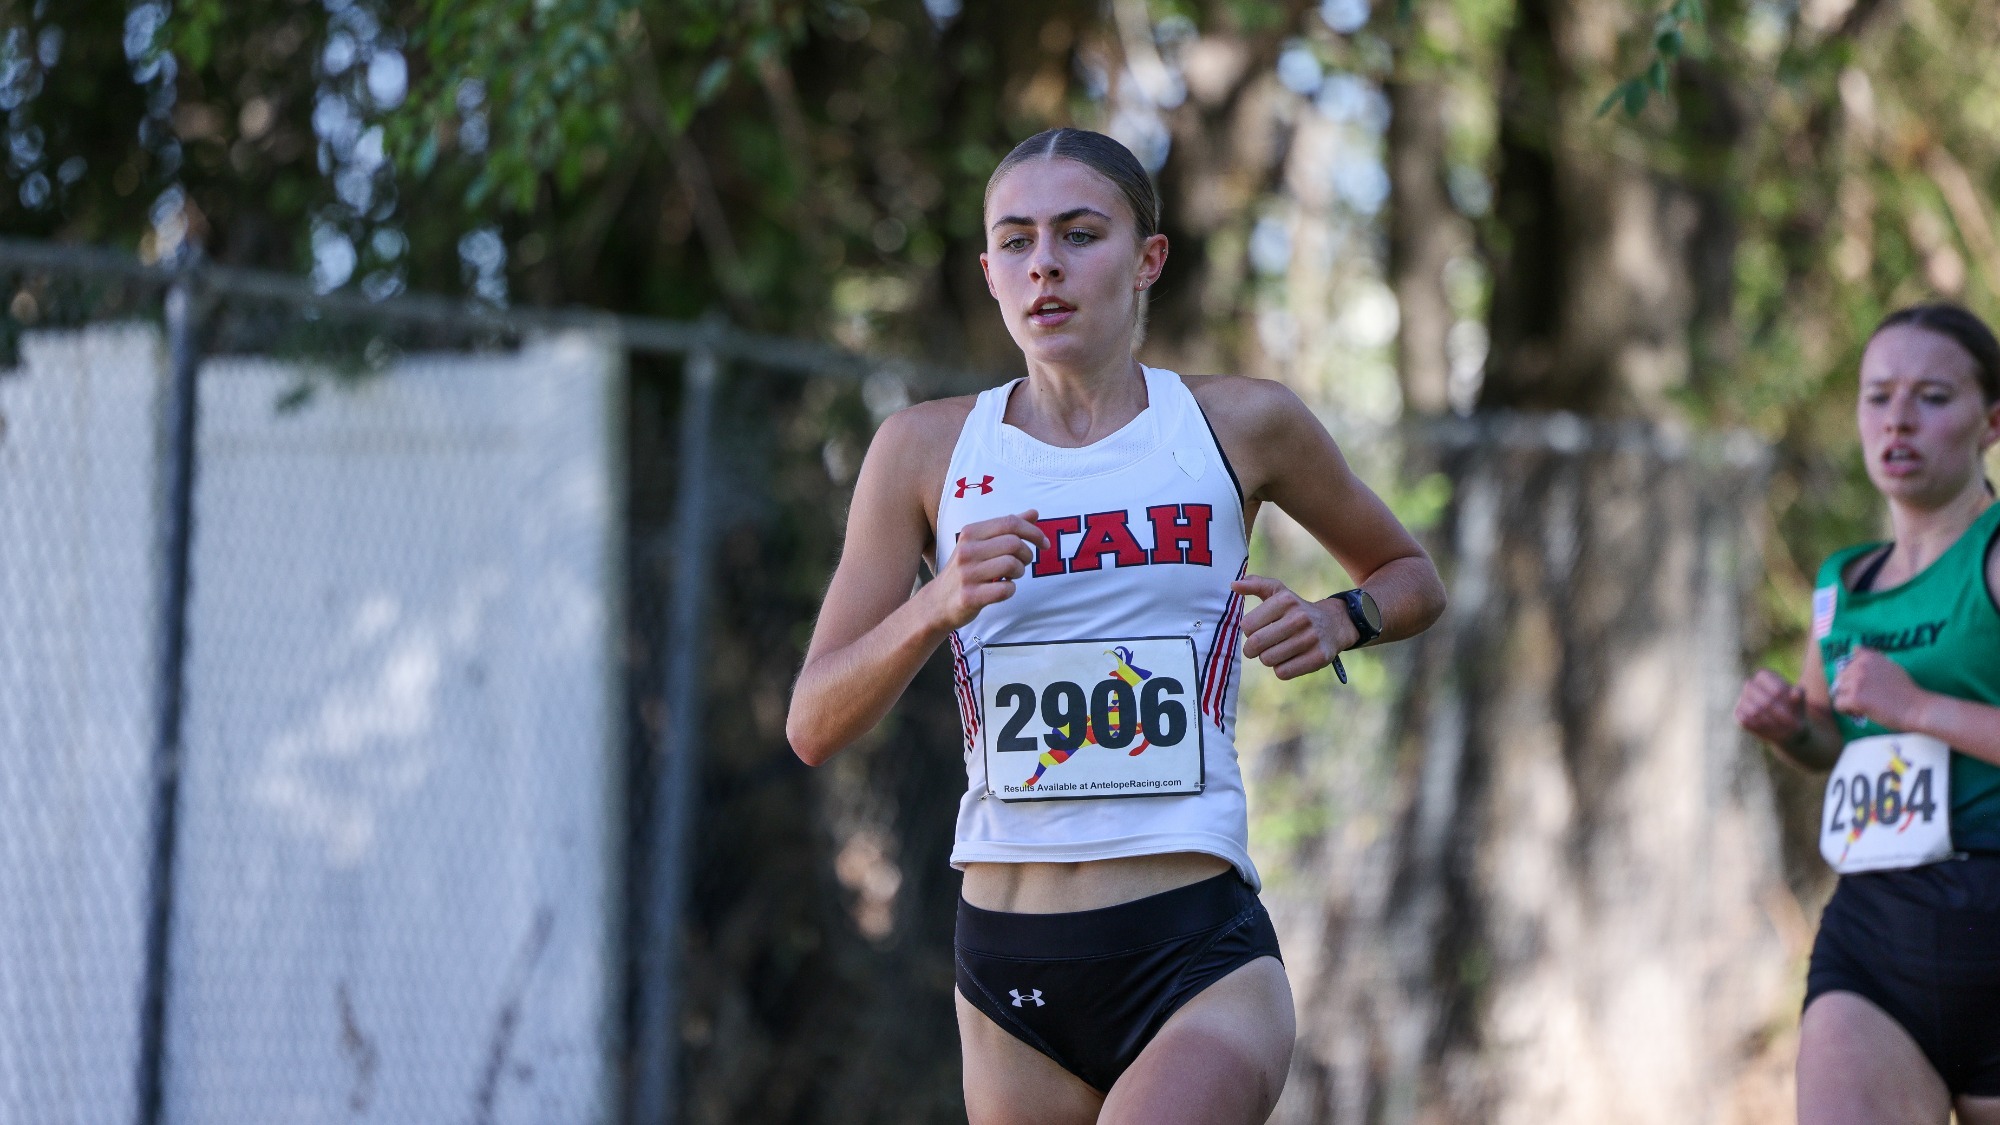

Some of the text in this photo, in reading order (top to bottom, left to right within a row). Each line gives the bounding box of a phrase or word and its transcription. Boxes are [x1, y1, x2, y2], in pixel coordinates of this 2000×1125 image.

[956, 503, 1213, 578] TAH
[996, 676, 1187, 753] 2906
[1004, 779, 1182, 793] Results Available at AntelopeRacing.com
[1829, 767, 1937, 832] 2964
